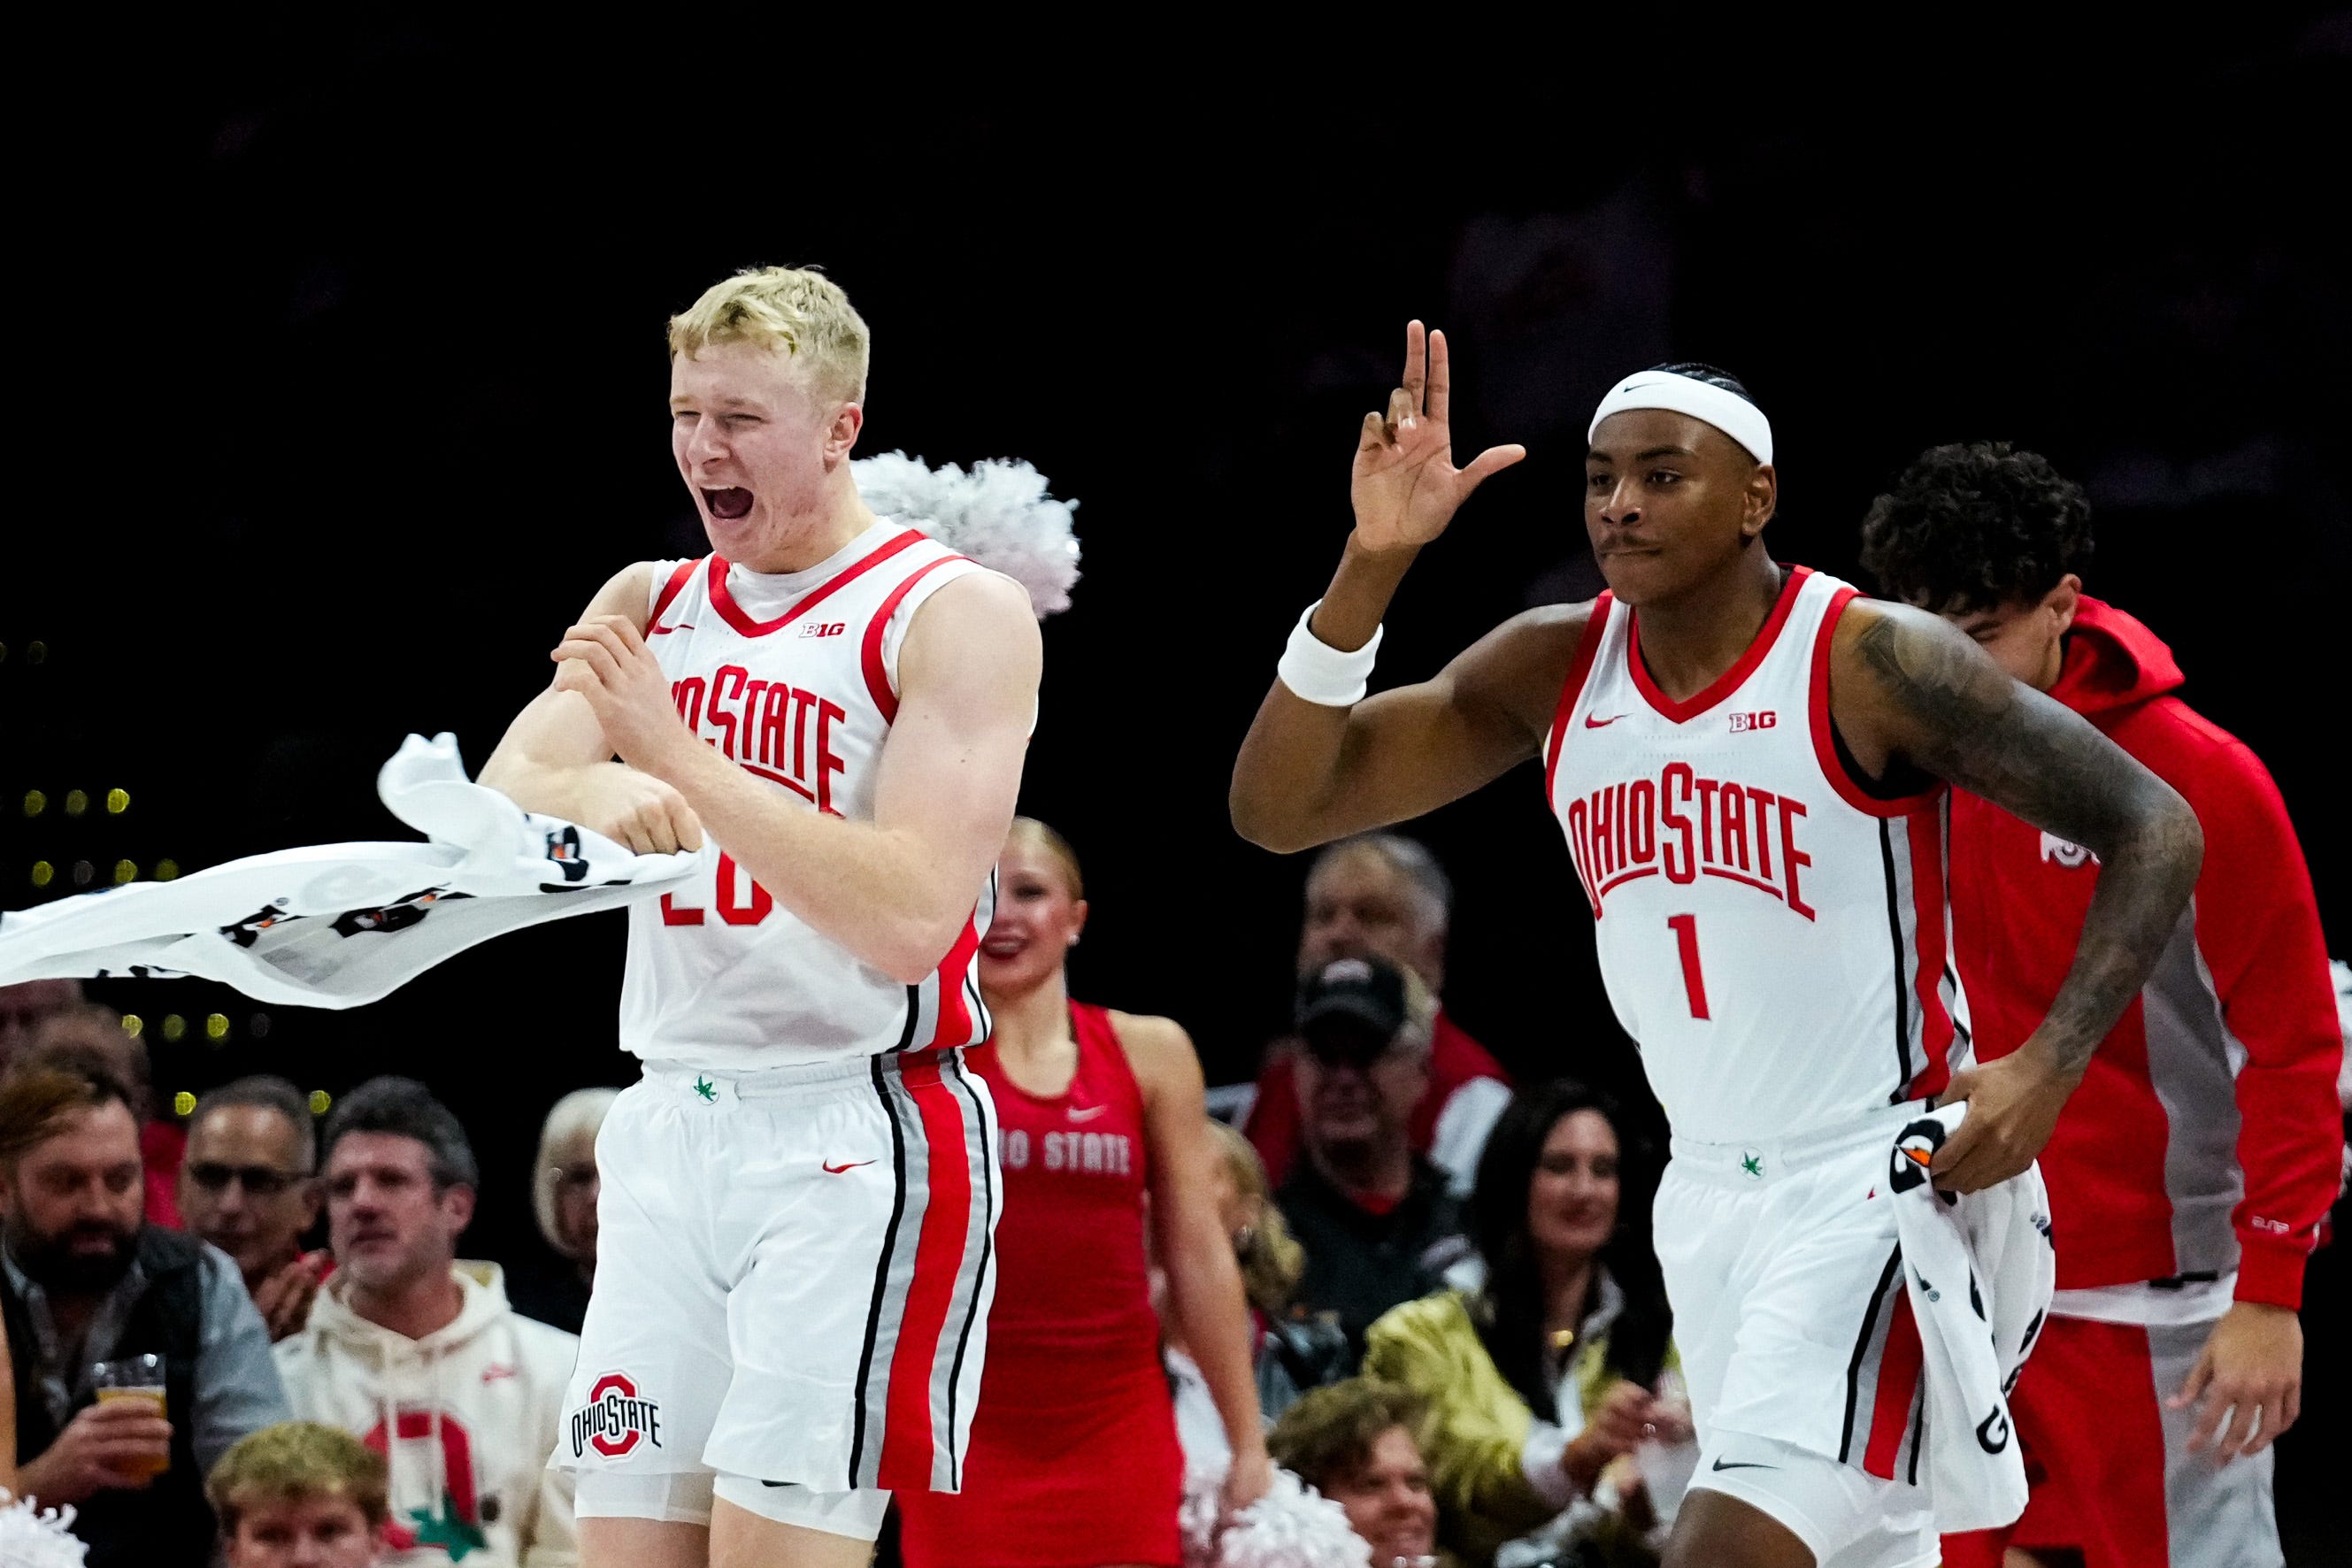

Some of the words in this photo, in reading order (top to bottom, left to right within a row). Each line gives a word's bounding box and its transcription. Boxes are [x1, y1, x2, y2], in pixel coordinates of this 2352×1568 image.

[707, 665, 847, 819] STATE
[1661, 762, 1815, 922] STATE
[1668, 914, 1710, 1020] 1
[1044, 1130, 1129, 1174] STATE
[607, 1395, 662, 1449] STATE
